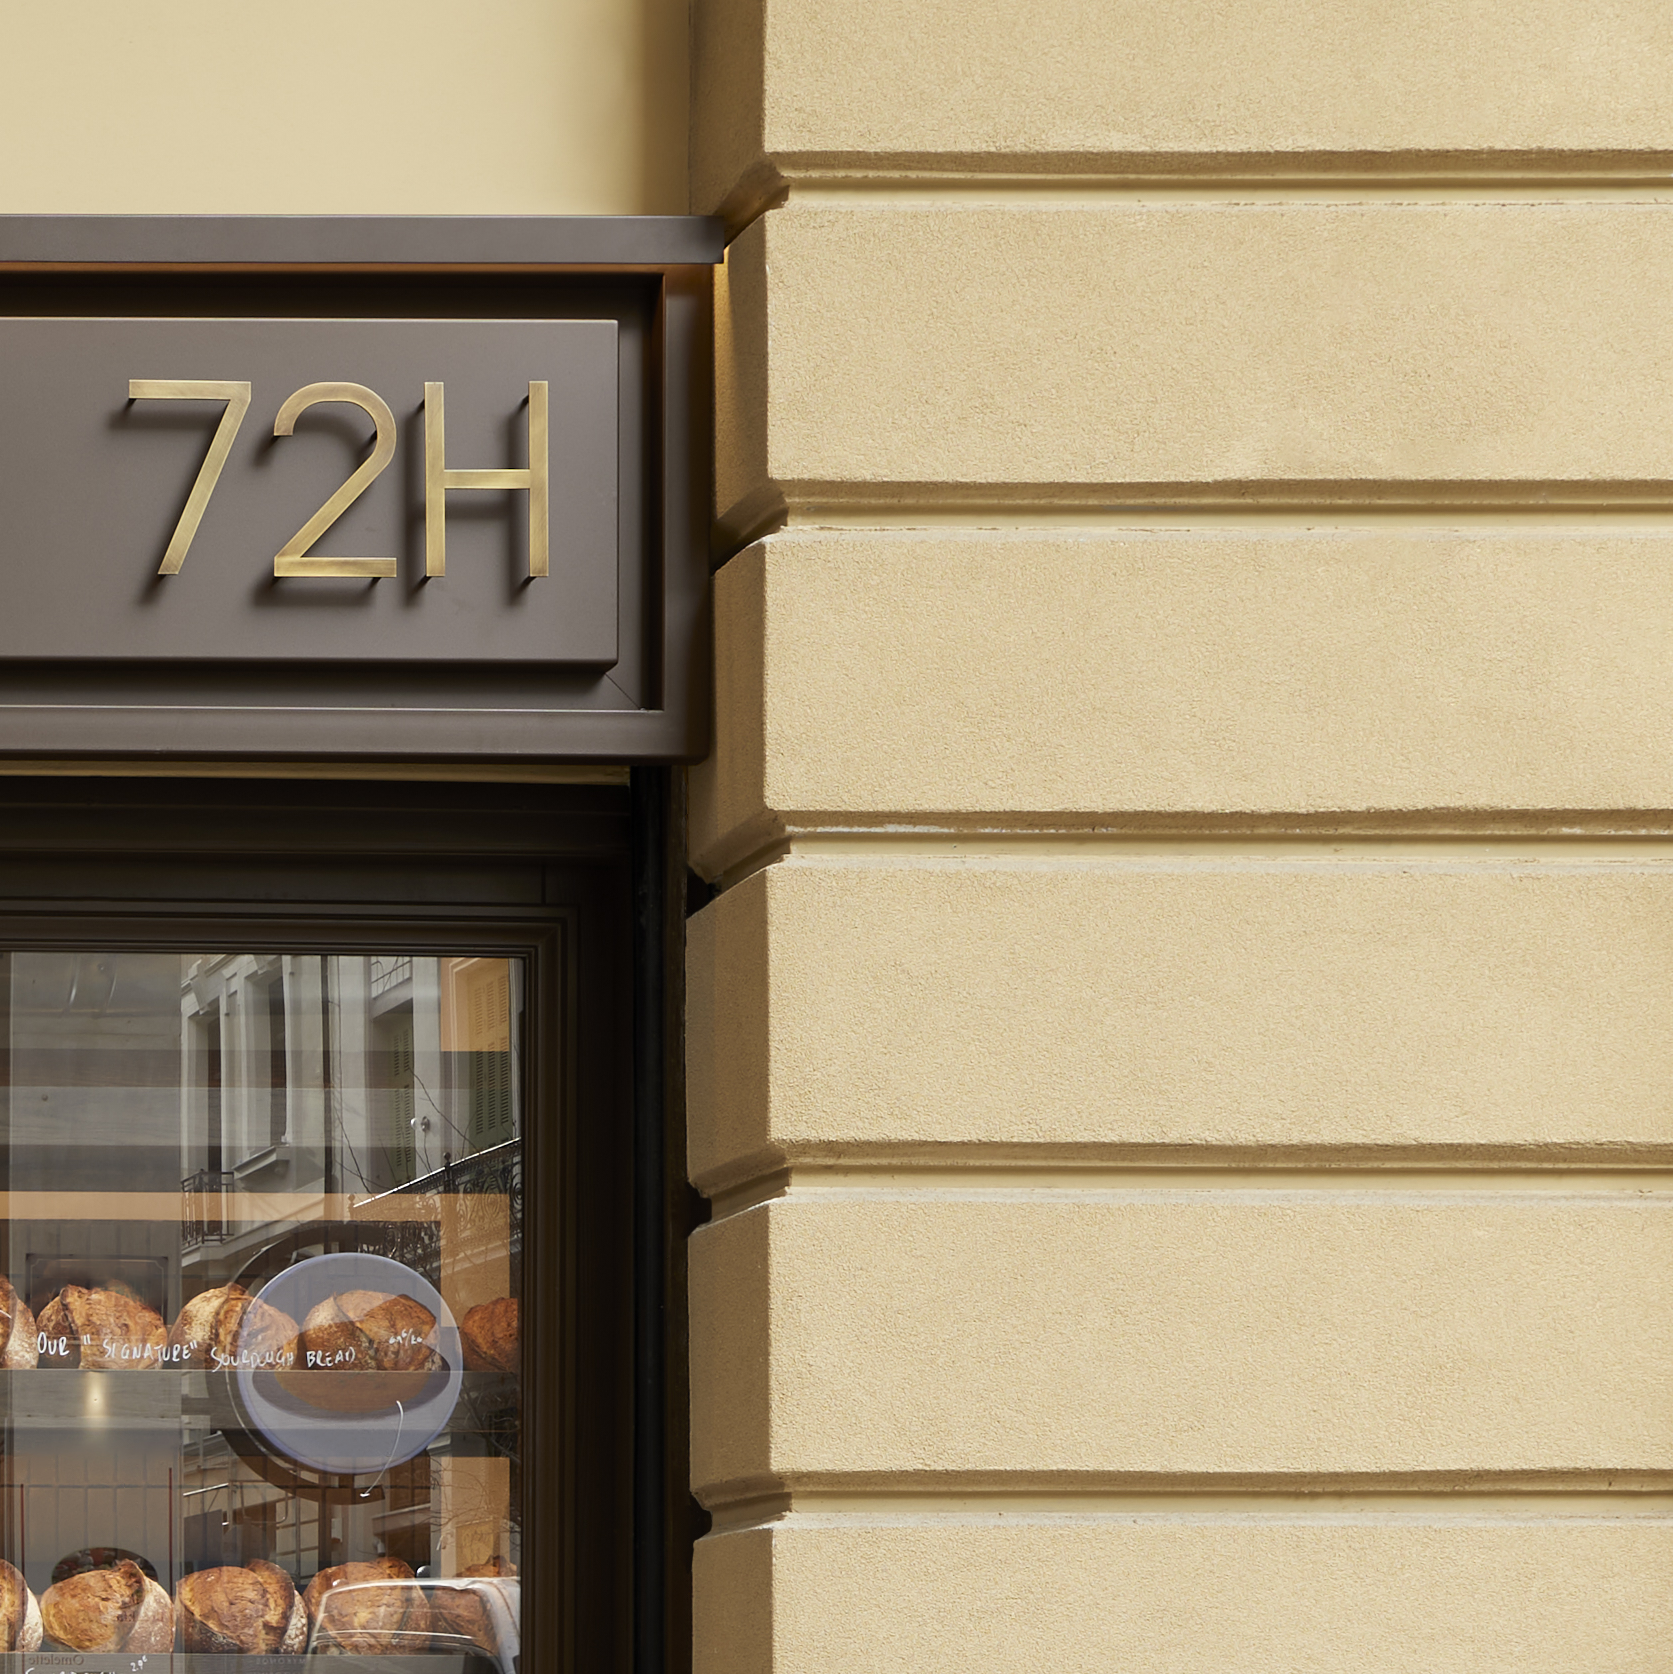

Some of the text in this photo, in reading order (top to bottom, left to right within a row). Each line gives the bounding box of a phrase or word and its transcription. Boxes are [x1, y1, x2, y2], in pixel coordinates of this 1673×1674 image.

[129, 379, 549, 577] 72H
[37, 1331, 70, 1356] OUR
[209, 1345, 295, 1373] SOURDOUGH
[306, 1345, 356, 1368] BREAD
